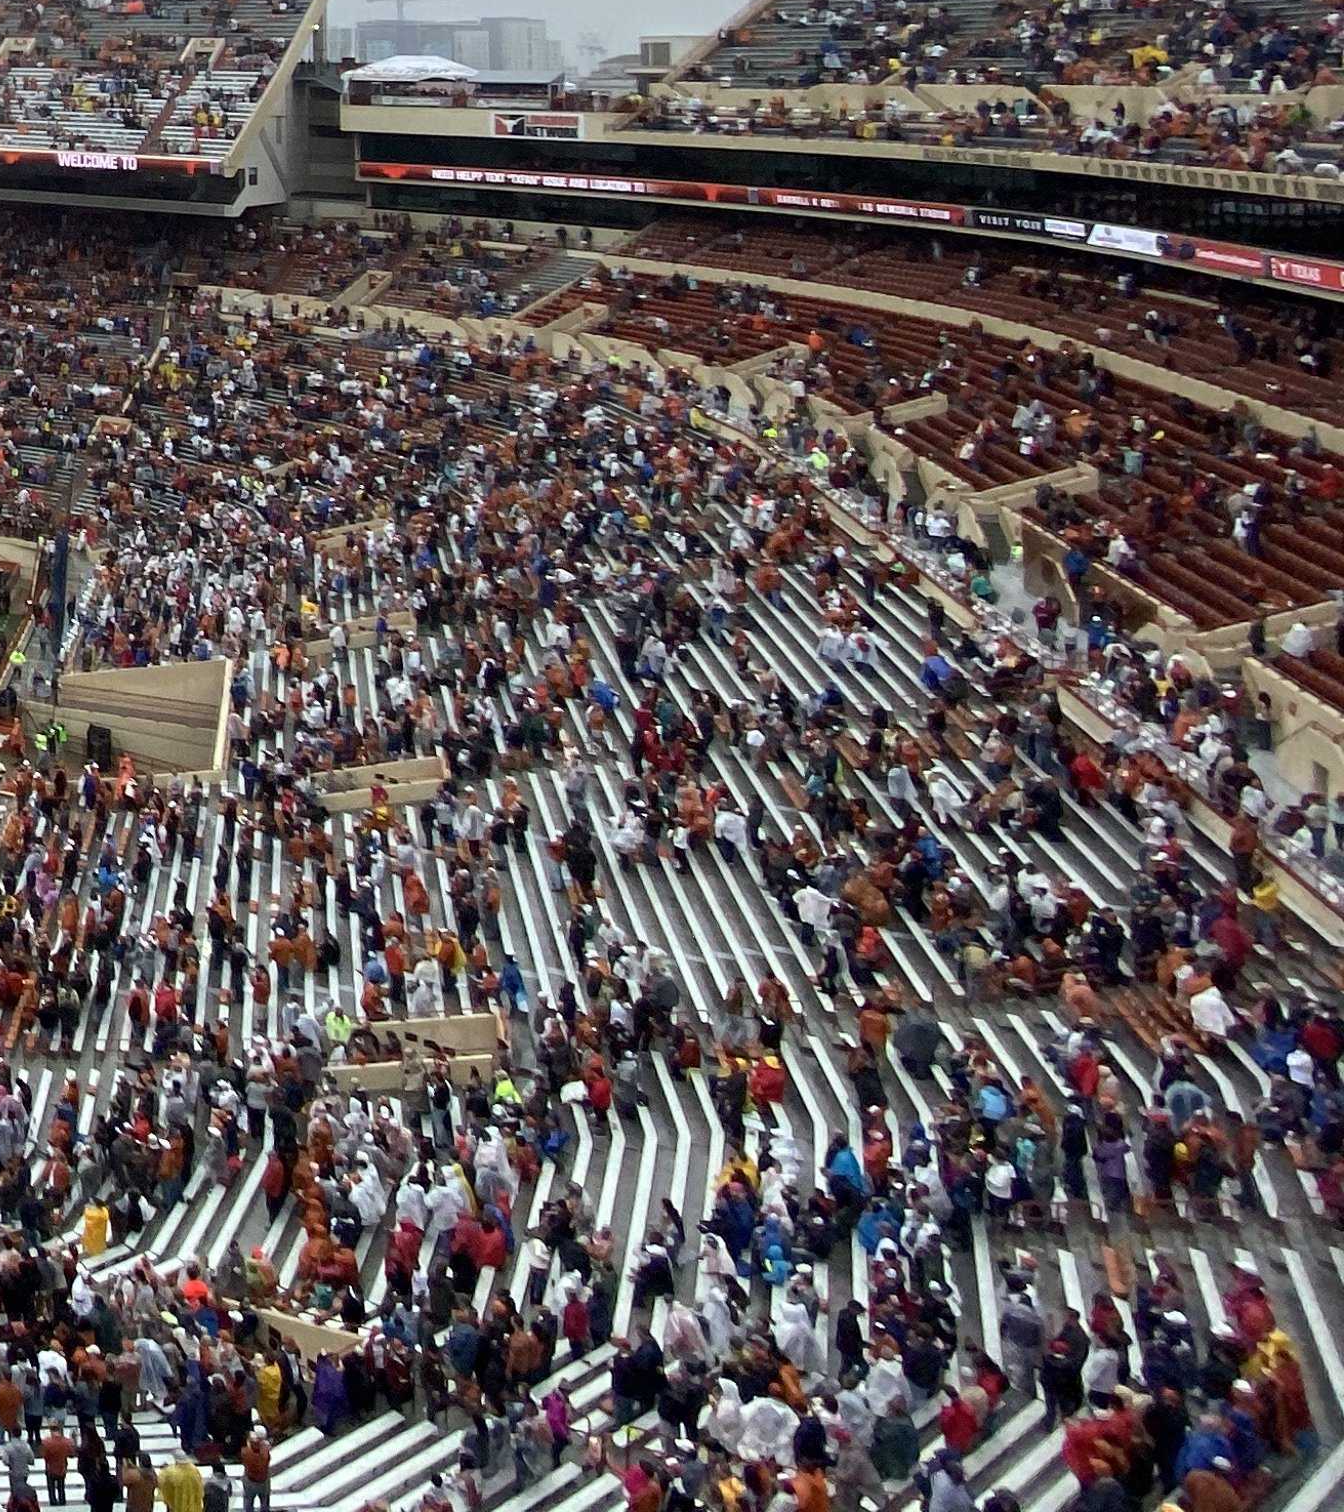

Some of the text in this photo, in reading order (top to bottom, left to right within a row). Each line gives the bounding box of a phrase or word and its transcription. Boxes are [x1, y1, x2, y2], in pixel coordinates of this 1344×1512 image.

[58, 153, 138, 171] WELCOME TO
[978, 214, 1010, 227] VISIT
